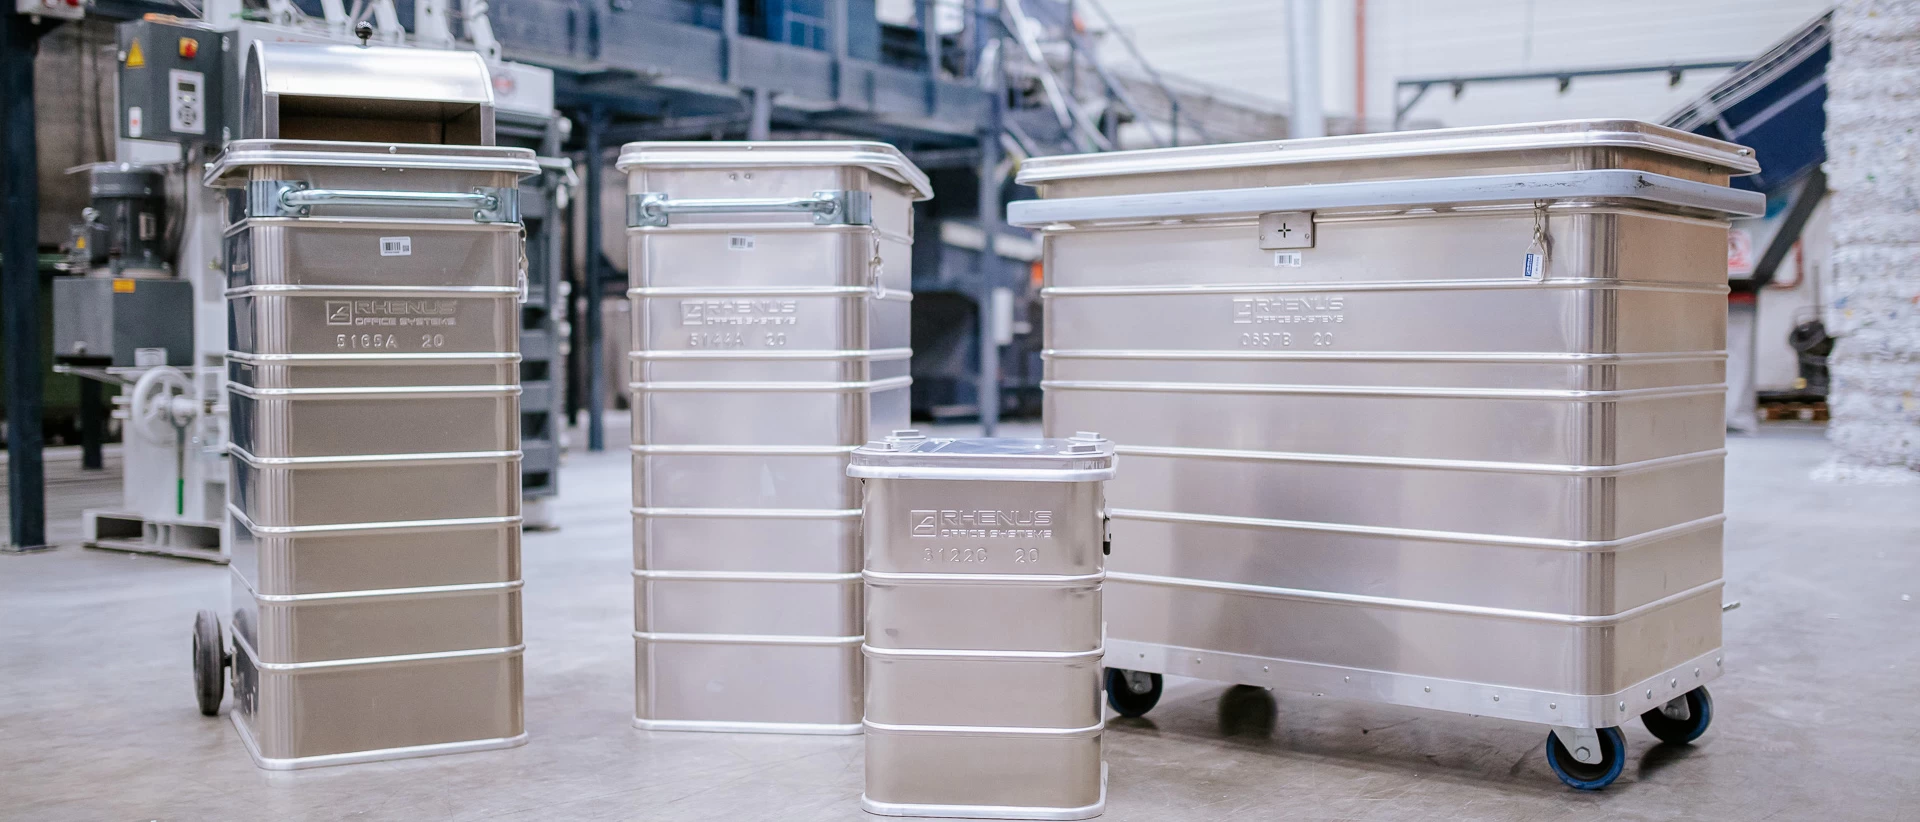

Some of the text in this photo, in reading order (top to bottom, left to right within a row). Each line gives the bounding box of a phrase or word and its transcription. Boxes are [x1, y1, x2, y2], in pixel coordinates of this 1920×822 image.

[354, 300, 457, 315] RHENUS
[706, 300, 796, 314] RHENUS
[1255, 298, 1344, 312] RHENUS
[355, 317, 457, 326] OFFICE SYSTEMS
[336, 334, 445, 349] 5165A 20
[765, 332, 786, 346] 20
[1313, 331, 1334, 346] 20
[940, 510, 1053, 526] RHENUS
[941, 529, 1053, 538] OFFICE SYSTEMS
[1015, 547, 1040, 563] 20
